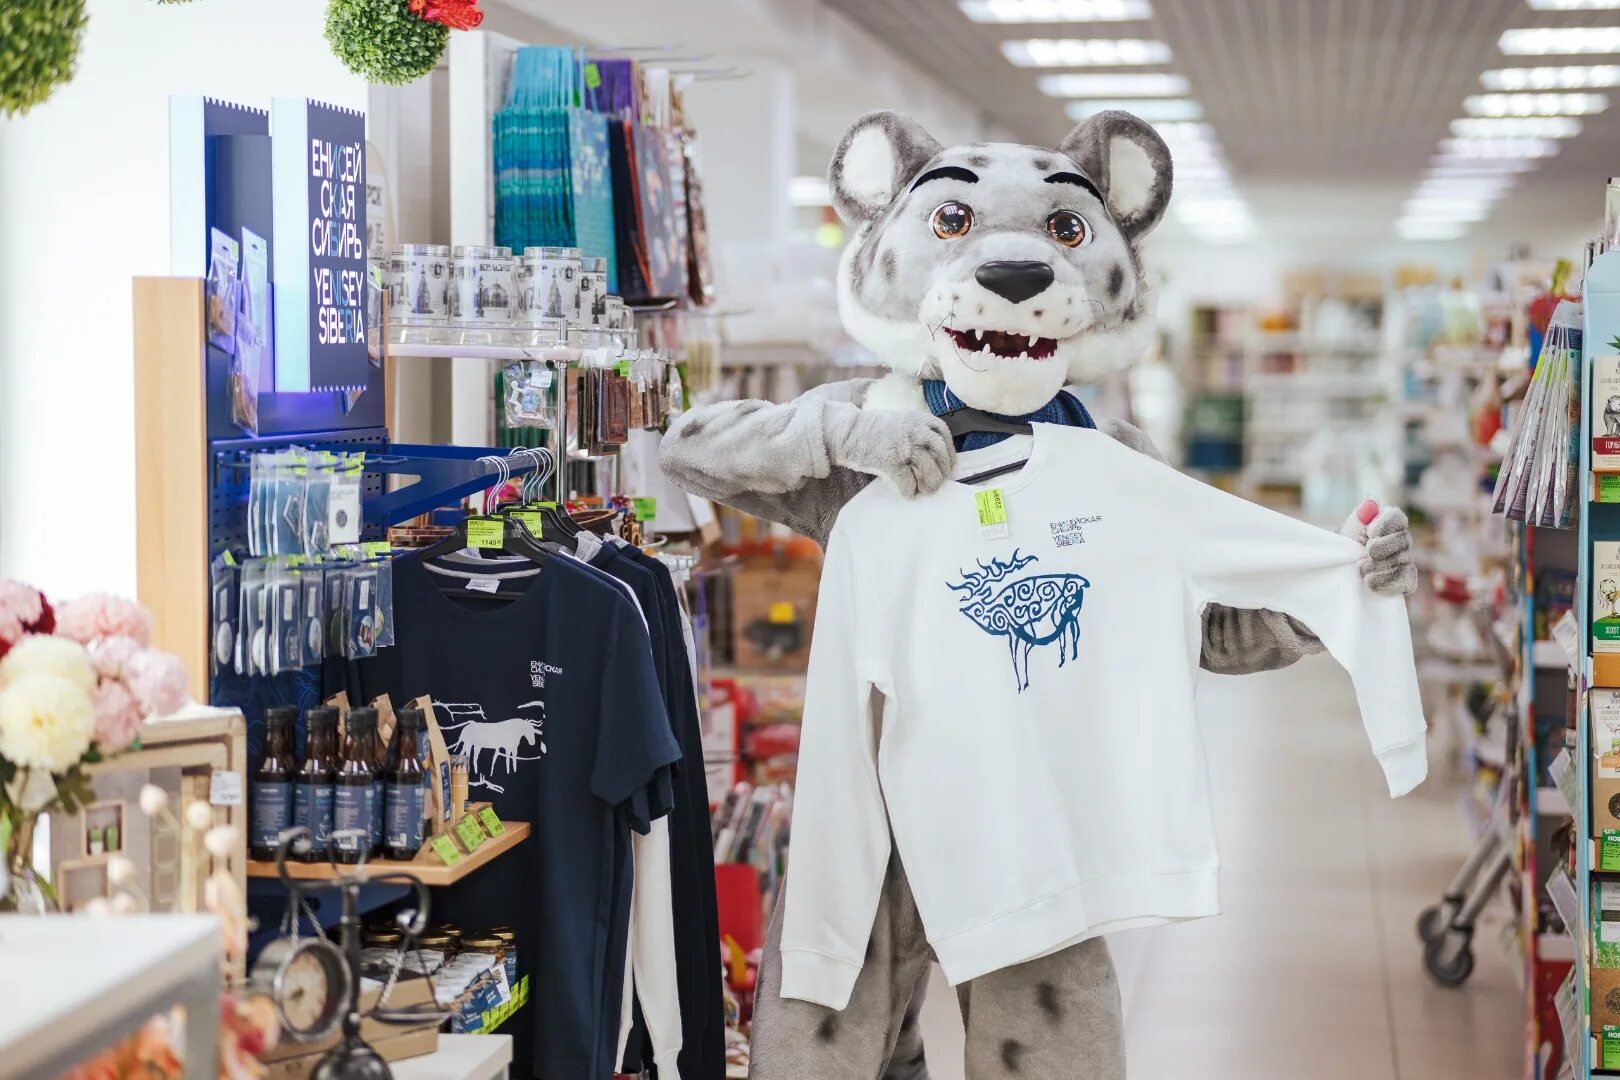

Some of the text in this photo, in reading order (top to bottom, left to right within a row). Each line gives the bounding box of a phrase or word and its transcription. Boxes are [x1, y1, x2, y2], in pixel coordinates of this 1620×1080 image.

[312, 139, 362, 184] ЕНИСЕЙ
[320, 180, 356, 221] СКАЯ
[312, 217, 362, 260] СИБИРЬ
[314, 267, 364, 307] YENISEY
[319, 306, 365, 345] SIBERIA
